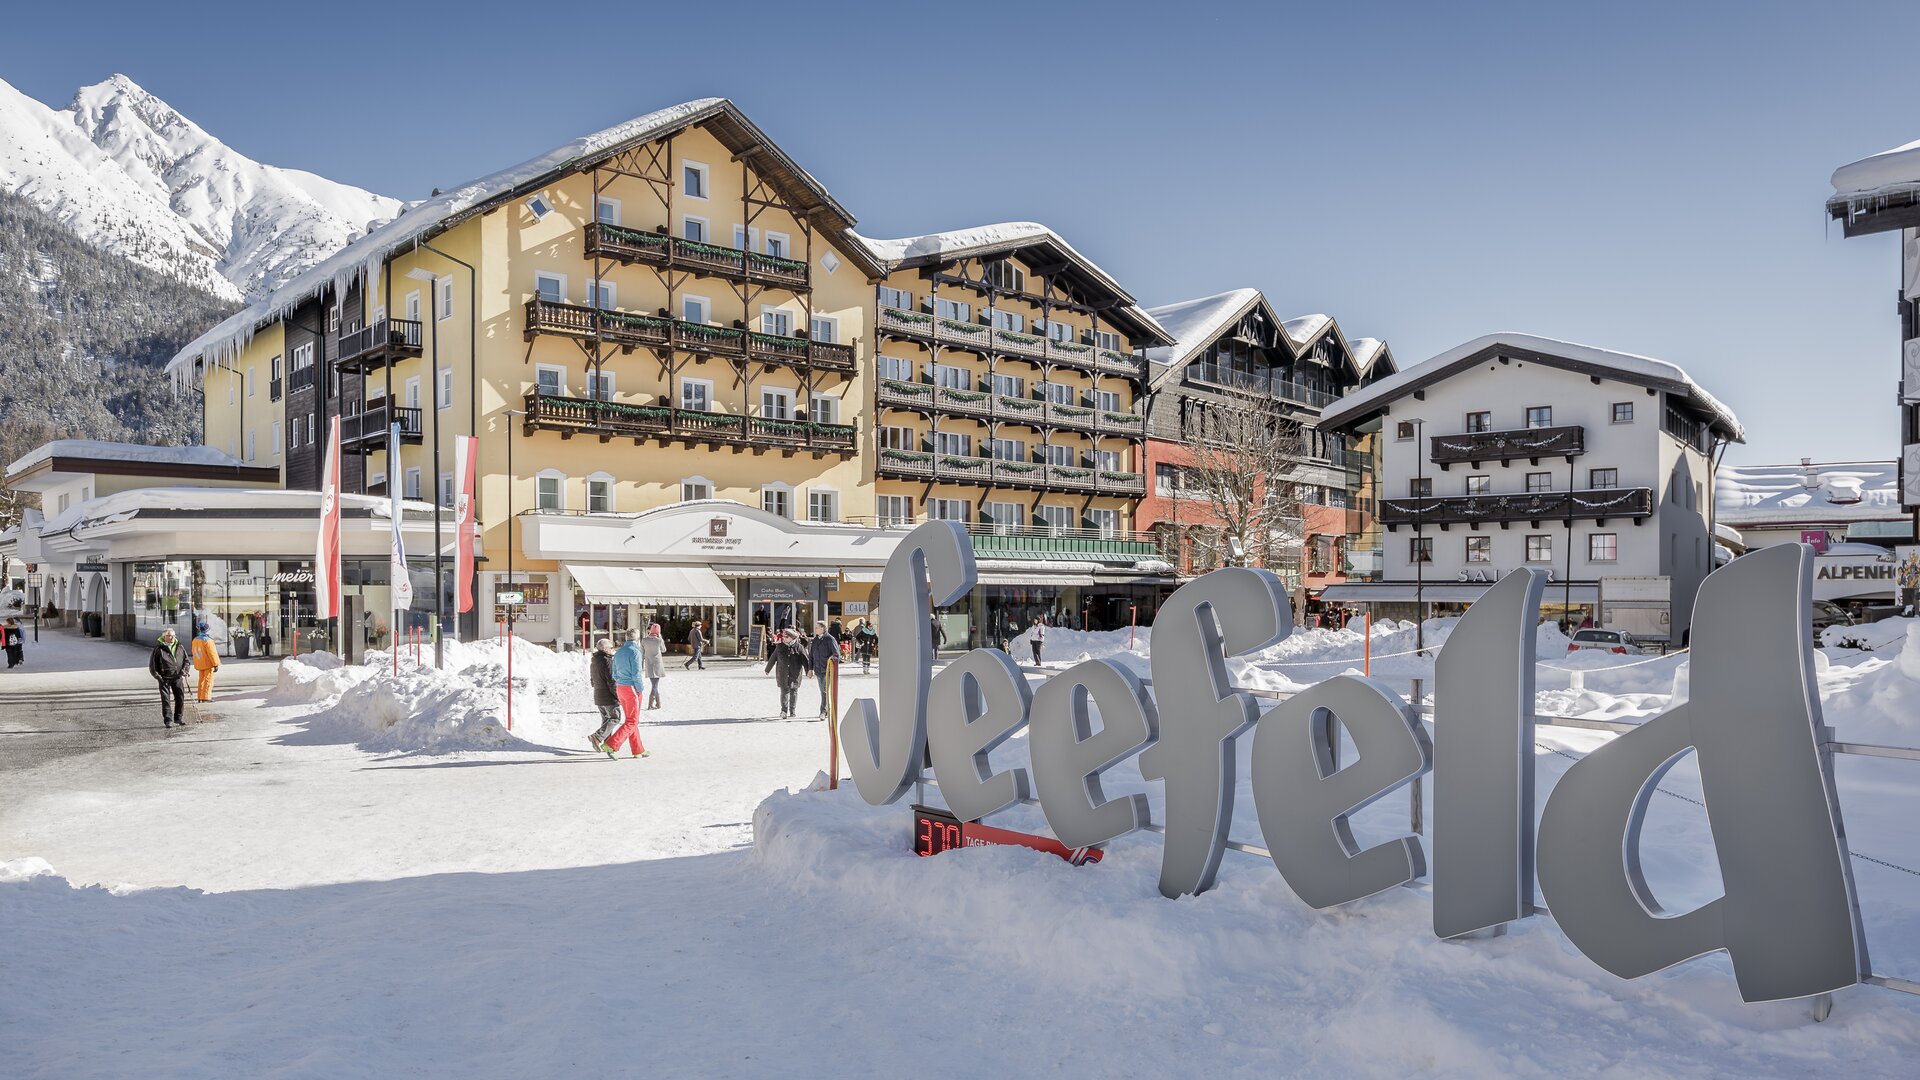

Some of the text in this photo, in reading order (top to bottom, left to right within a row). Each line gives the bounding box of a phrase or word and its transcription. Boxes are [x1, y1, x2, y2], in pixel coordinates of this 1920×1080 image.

[272, 568, 315, 583] meier
[1458, 569, 1555, 583] SAIR
[1817, 566, 1896, 580] ALPENH
[840, 520, 1870, 1003] Seefeld
[921, 819, 961, 857] 370
